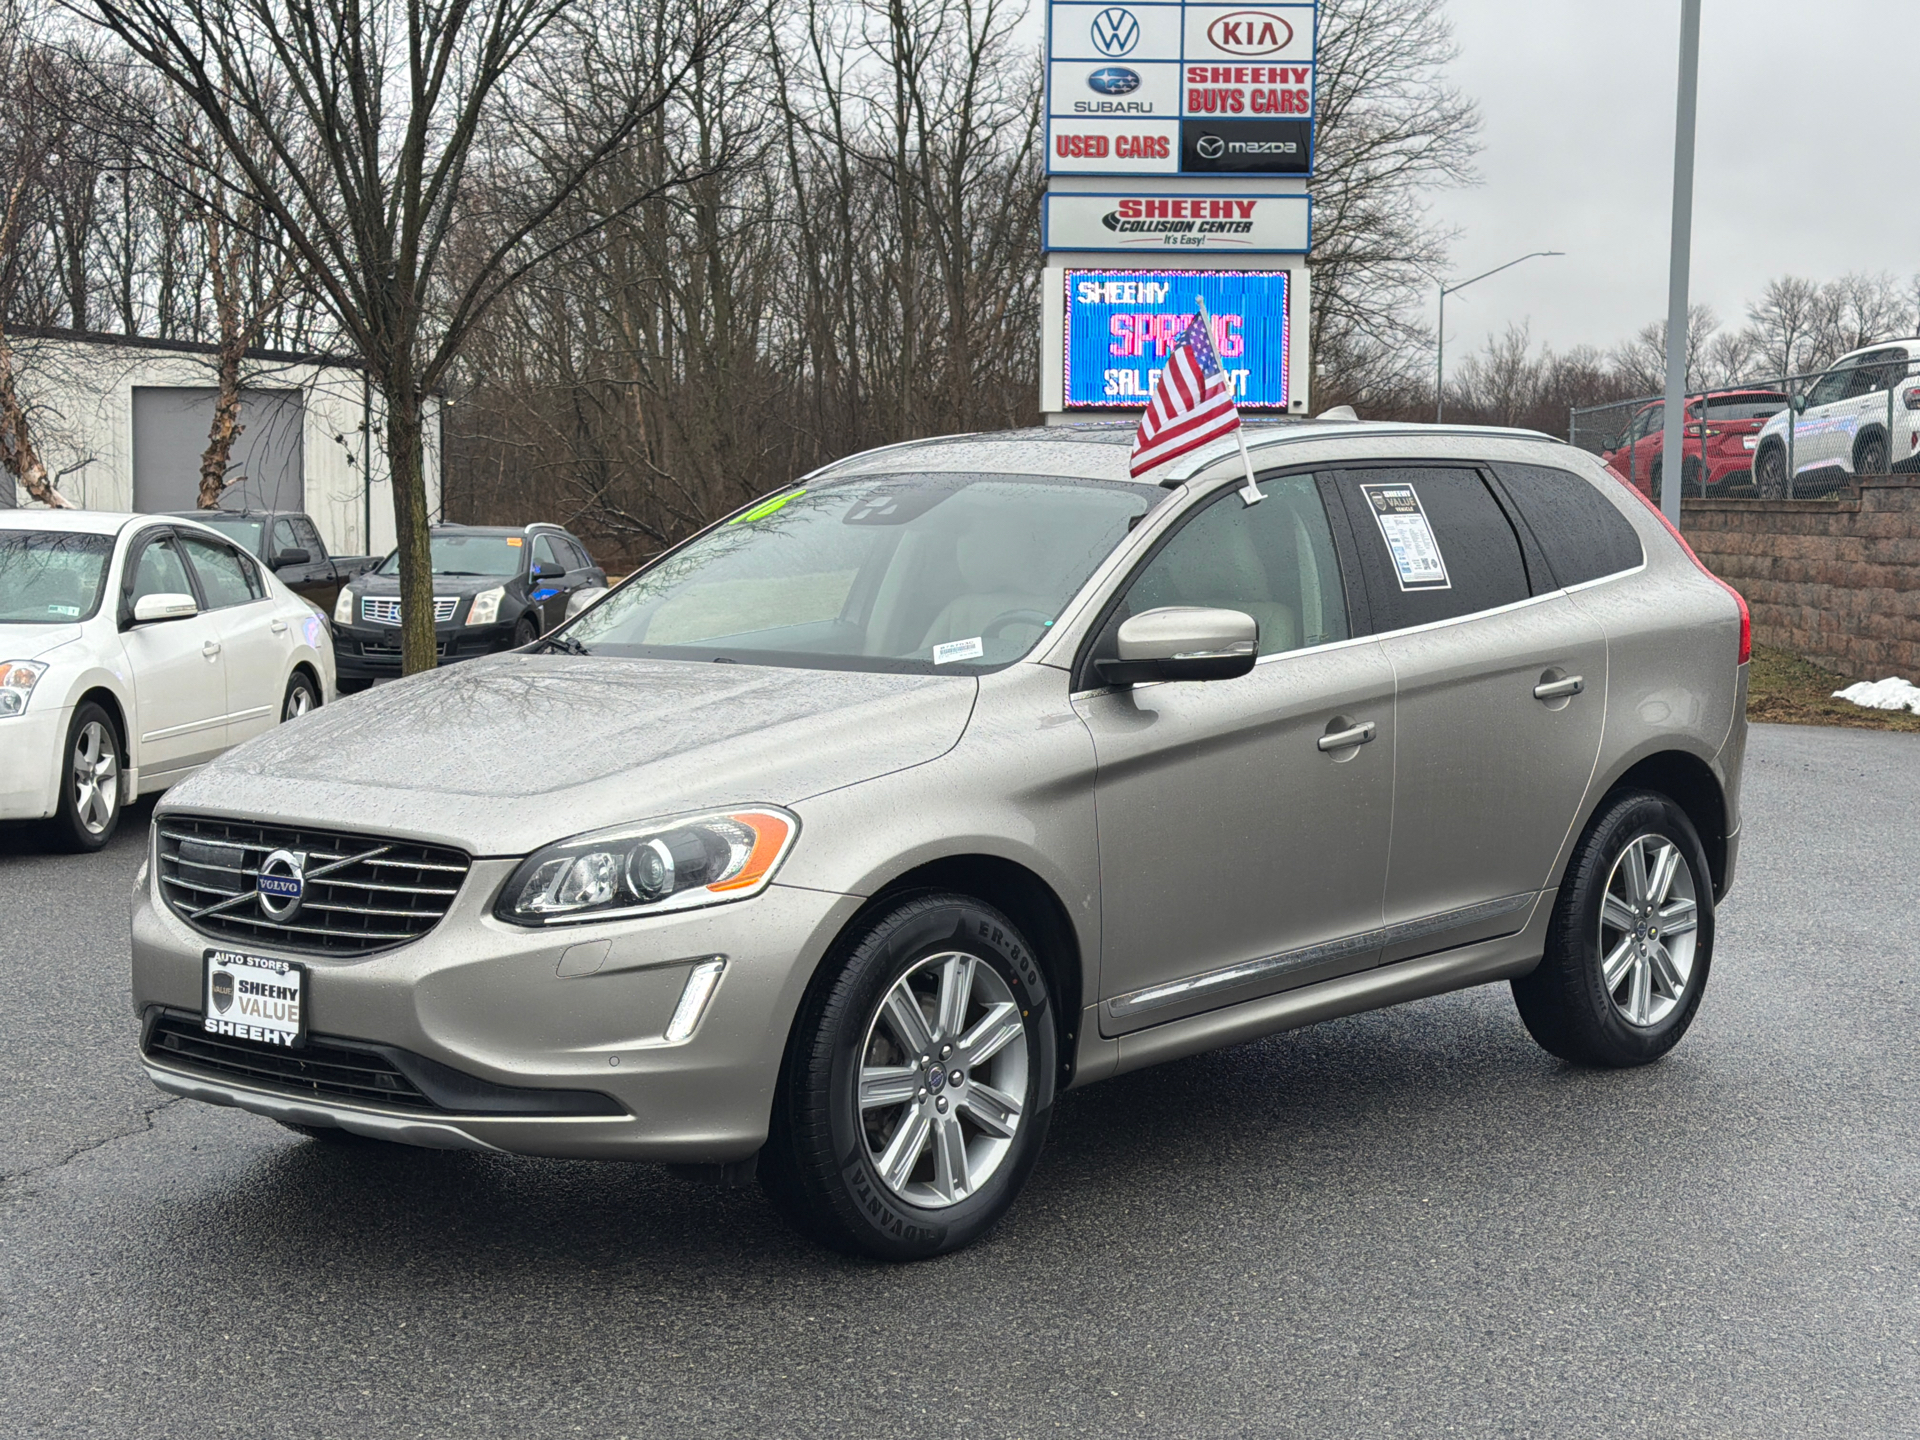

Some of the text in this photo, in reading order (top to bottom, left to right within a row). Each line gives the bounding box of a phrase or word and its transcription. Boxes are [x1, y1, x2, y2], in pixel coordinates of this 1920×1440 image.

[1222, 22, 1279, 45] KIA
[1187, 66, 1311, 84] SHEEHY
[1073, 101, 1153, 113] SUBARU
[1187, 88, 1310, 114] BUYS CARS
[1056, 134, 1170, 158] USED CARS
[1118, 199, 1258, 219] SHEEHY
[1118, 220, 1254, 233] COLLISION CENTER
[1163, 234, 1206, 247] It's Easy!
[1077, 282, 1169, 304] SHEEHY
[1386, 498, 1416, 507] VALUE
[259, 878, 298, 893] VOLVO
[213, 952, 290, 971] AUTO STORES
[978, 920, 1037, 986] ER-800
[212, 985, 233, 996] VALUE
[238, 979, 299, 1002] SHEEHY
[238, 995, 299, 1023] VALUE
[204, 1018, 297, 1047] SHEEHY
